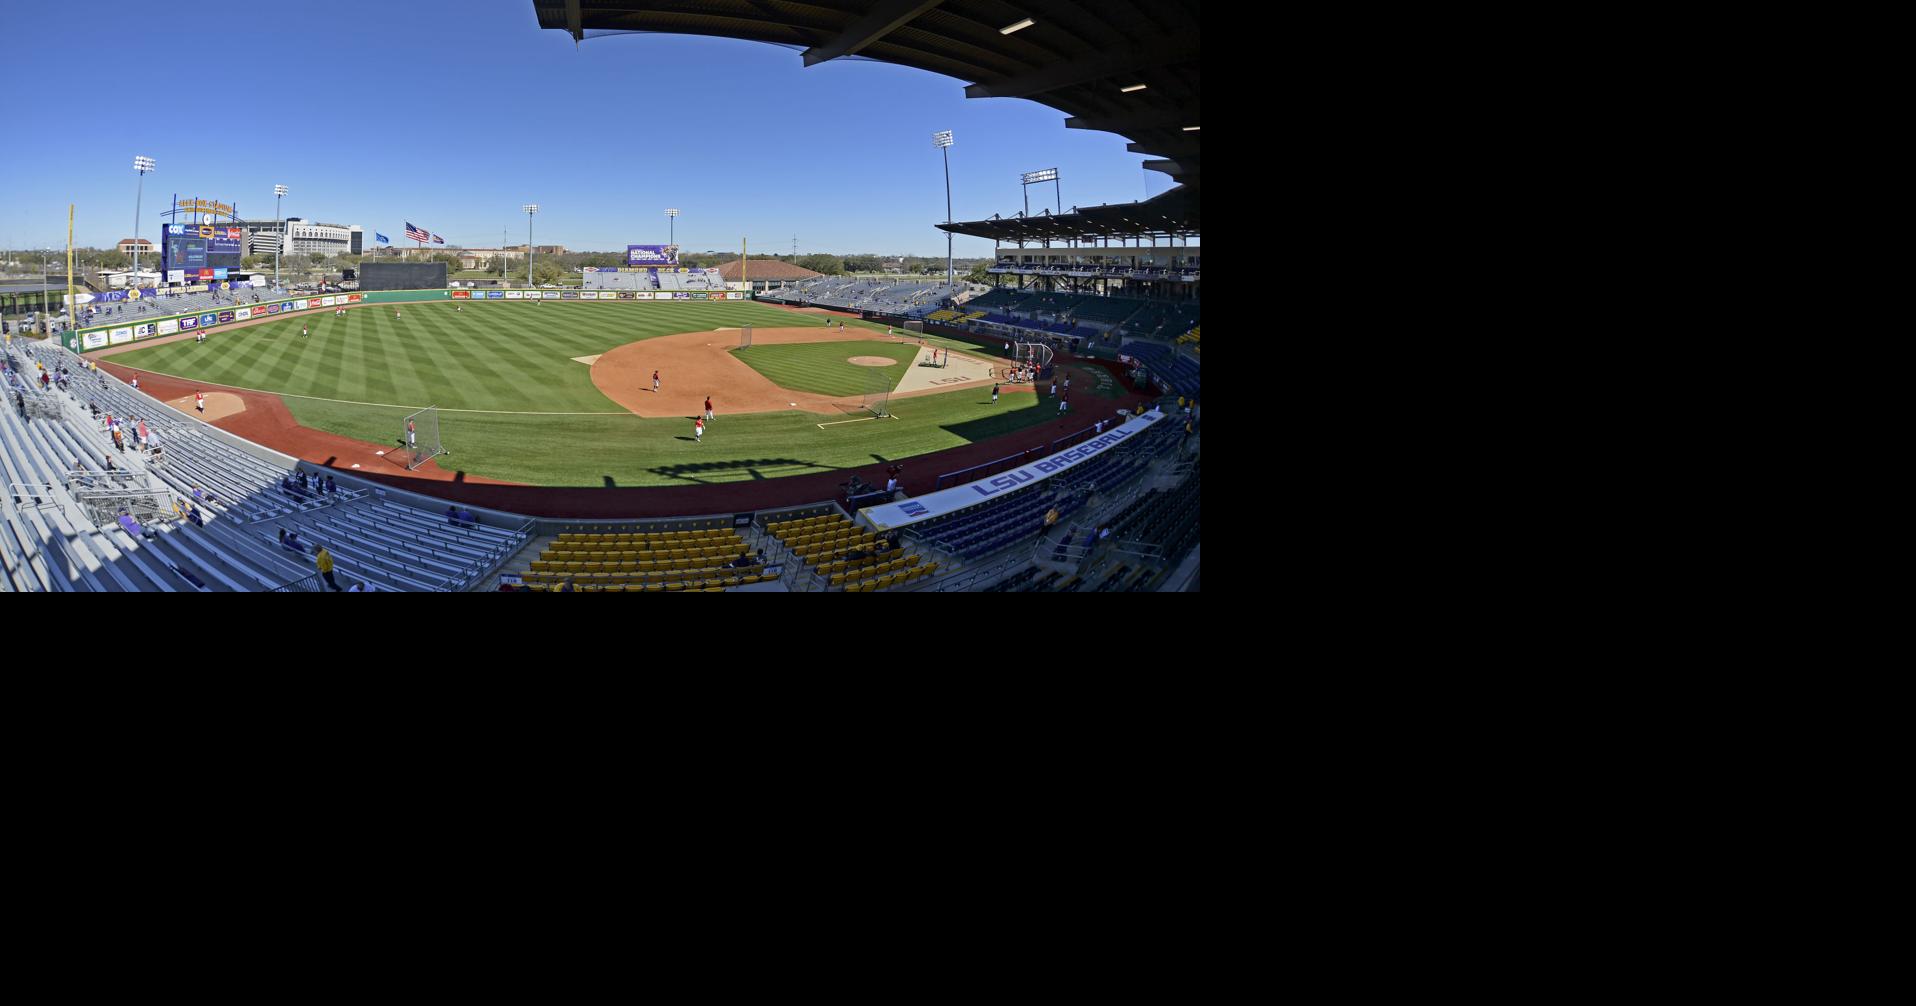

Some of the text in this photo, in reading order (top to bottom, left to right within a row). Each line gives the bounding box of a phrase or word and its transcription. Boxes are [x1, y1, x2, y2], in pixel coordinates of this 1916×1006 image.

[168, 225, 184, 235] COX
[929, 376, 971, 386] LSU
[971, 429, 1133, 497] LSU BASEBALL
